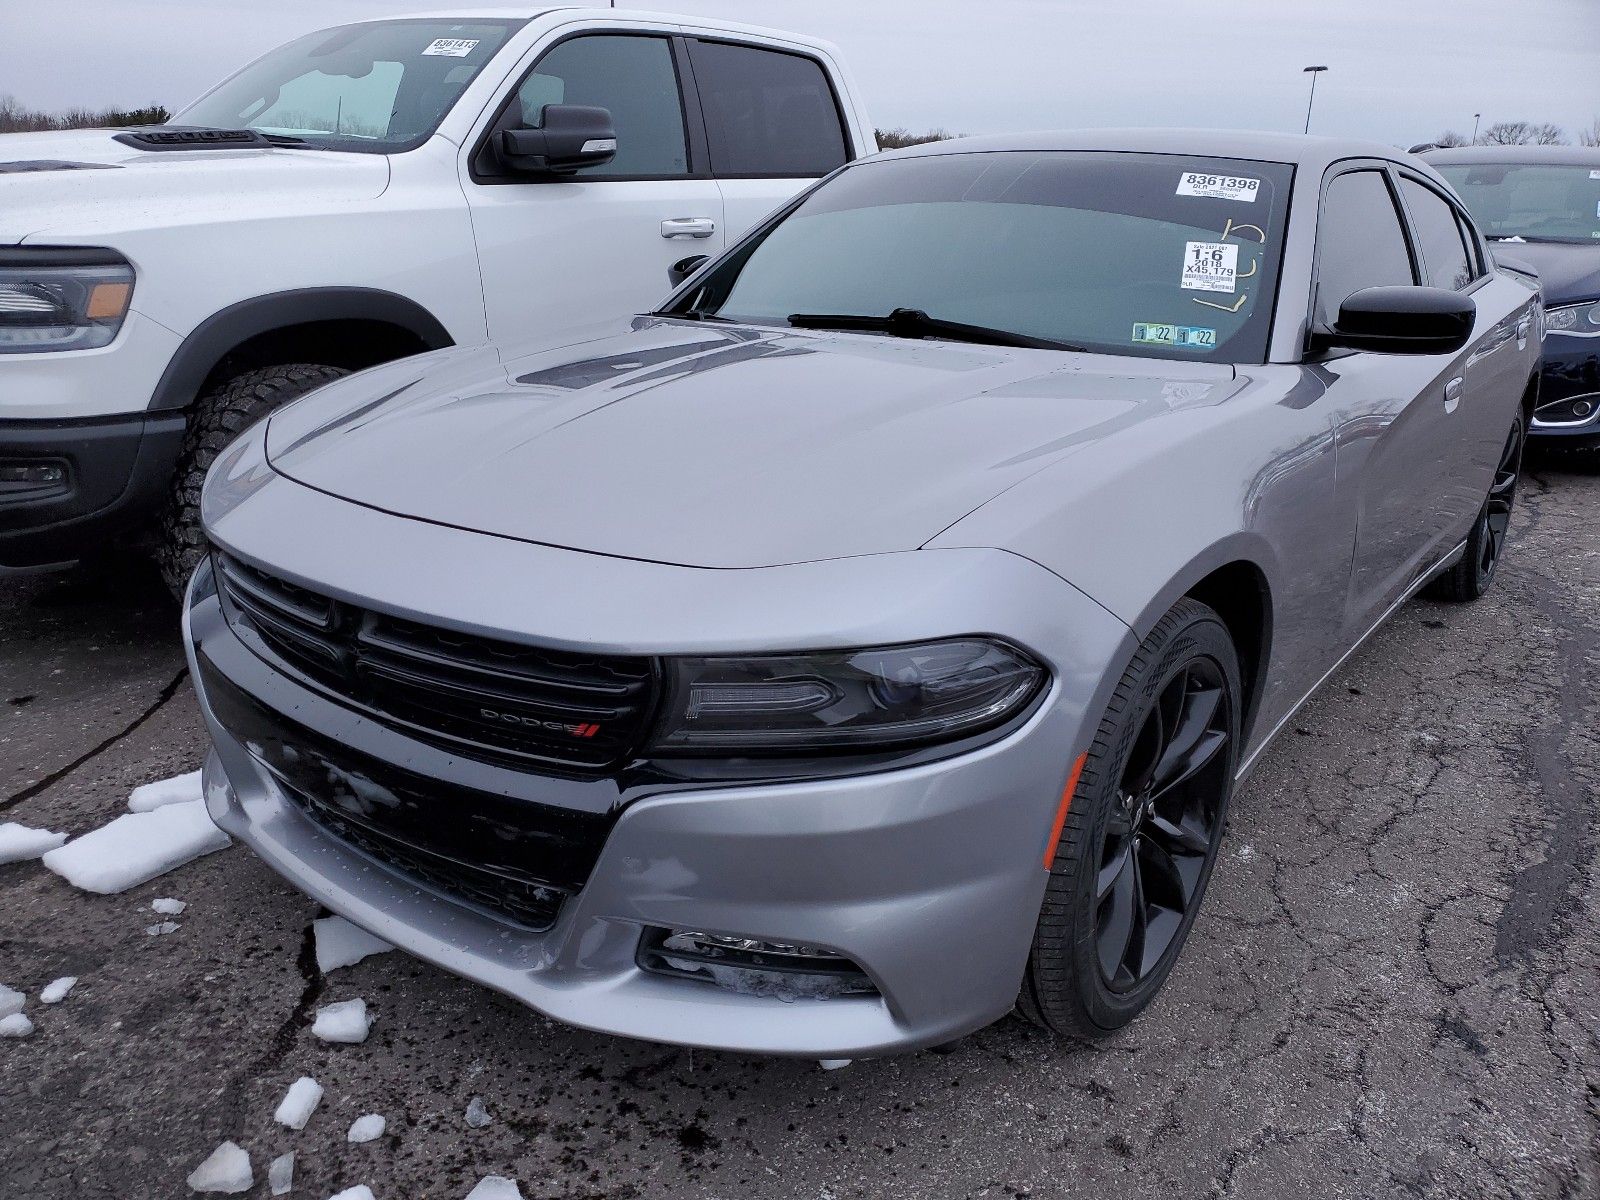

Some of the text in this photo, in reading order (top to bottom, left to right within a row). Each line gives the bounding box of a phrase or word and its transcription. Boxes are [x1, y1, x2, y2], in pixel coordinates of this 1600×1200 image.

[1187, 174, 1257, 190] 8361398
[1186, 265, 1234, 276] X45,179
[1157, 327, 1170, 340] 22
[1199, 331, 1212, 344] 22
[480, 708, 585, 734] DODGE
